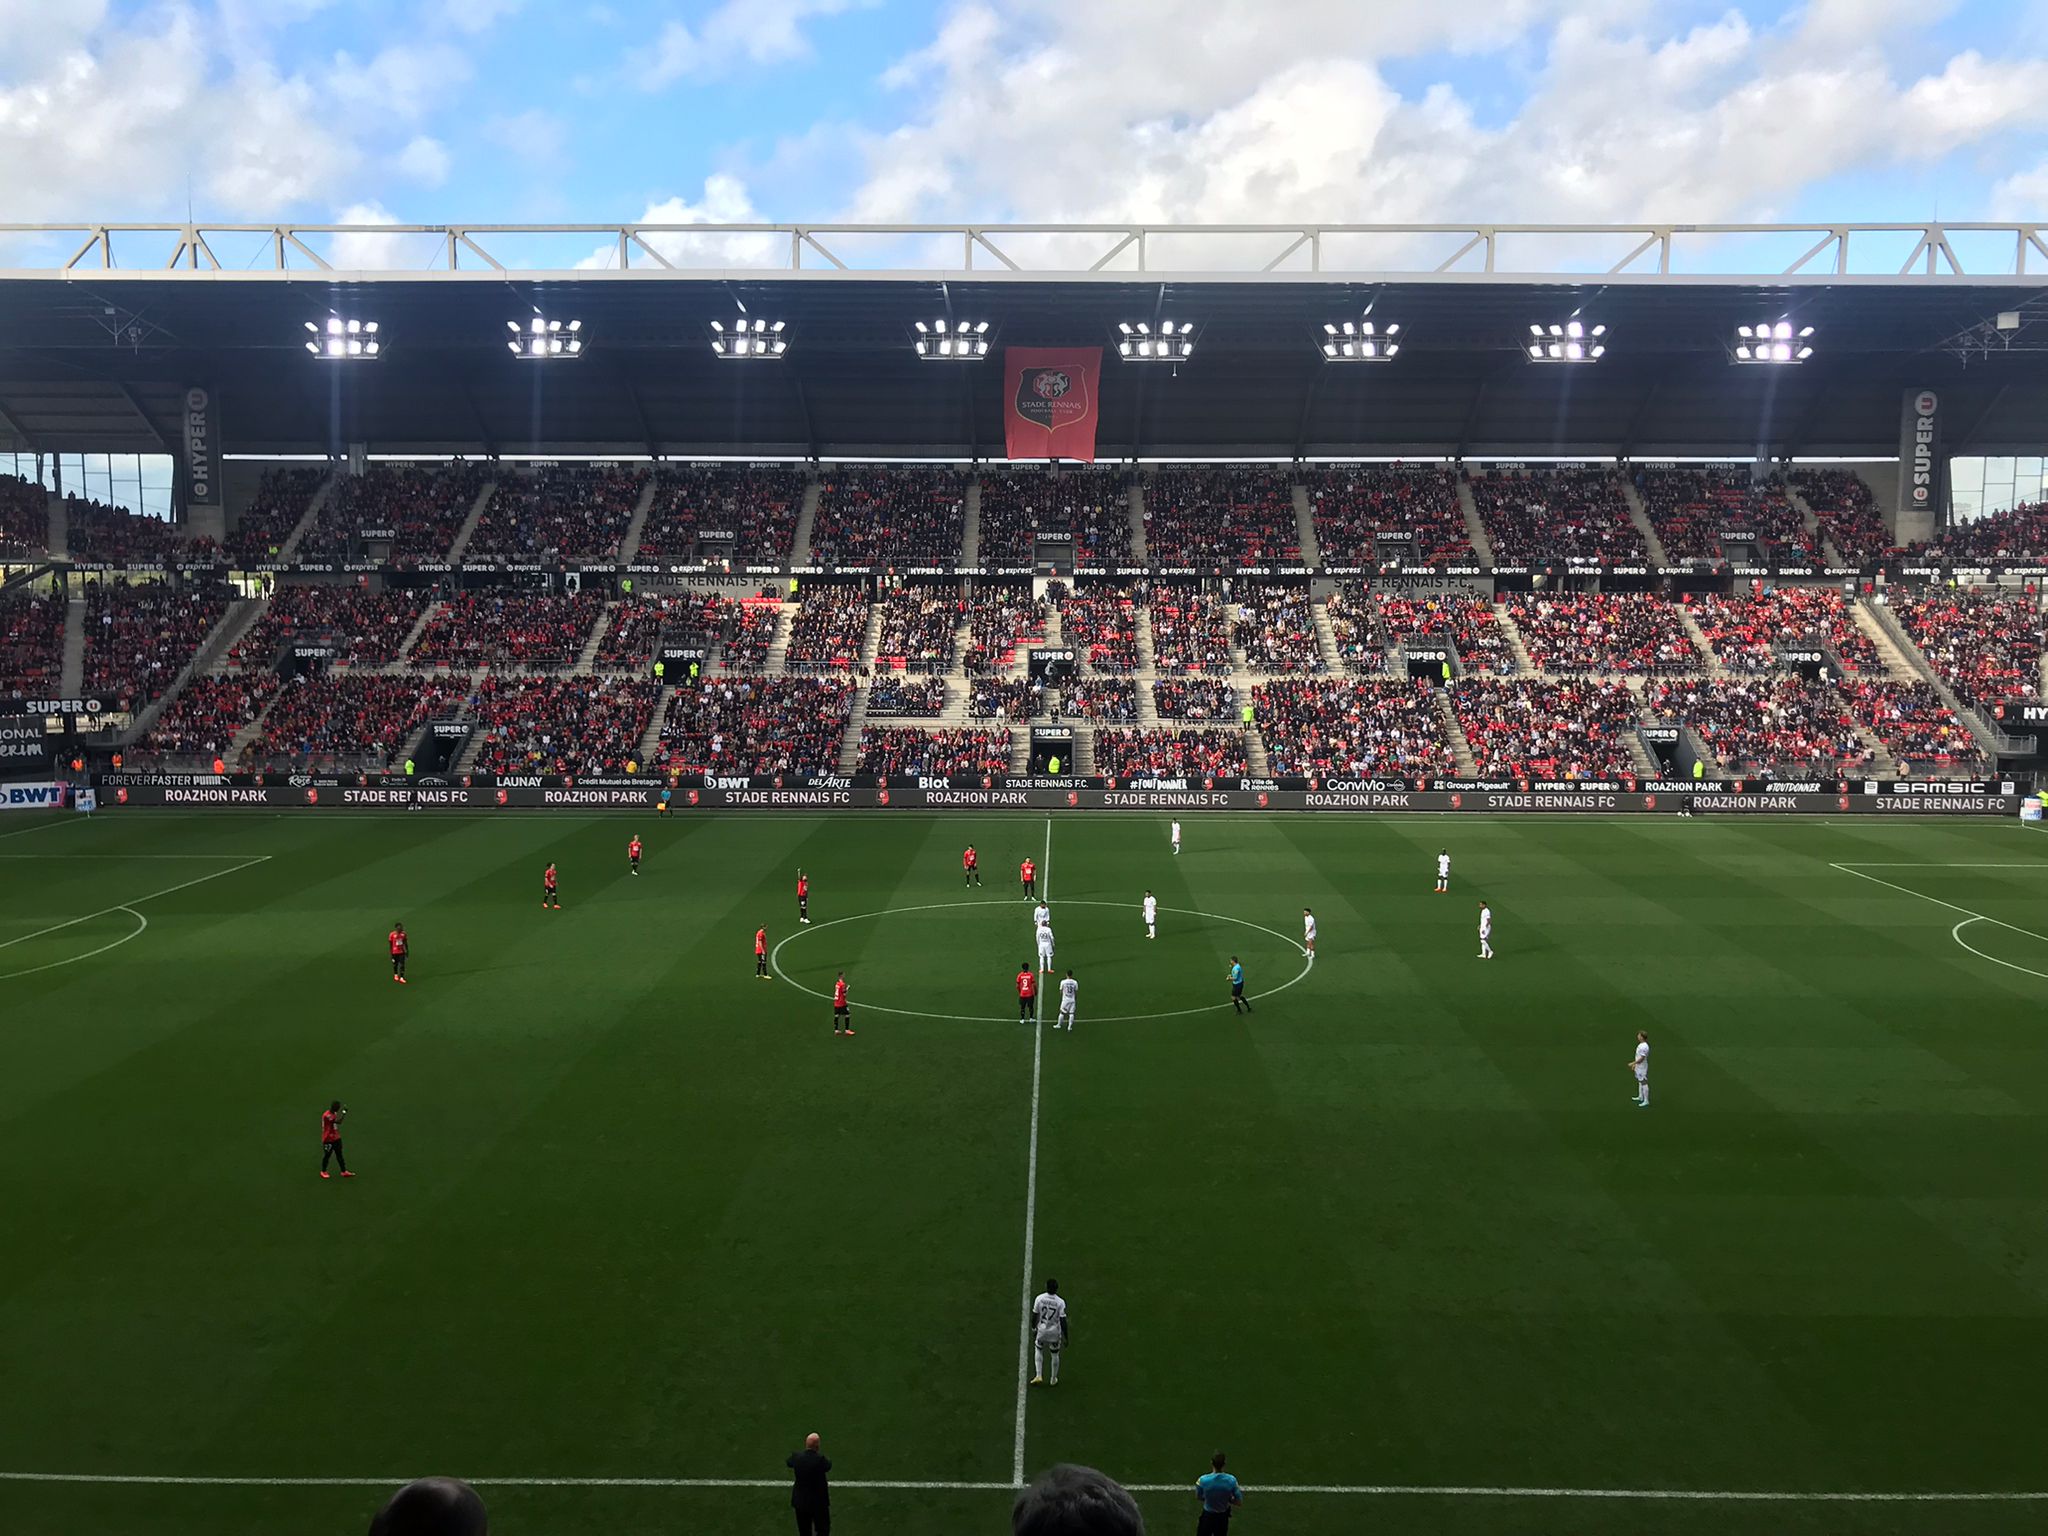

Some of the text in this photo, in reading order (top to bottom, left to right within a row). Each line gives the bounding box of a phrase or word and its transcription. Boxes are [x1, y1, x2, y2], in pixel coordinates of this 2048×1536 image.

[190, 412, 208, 480] HYPER
[1914, 417, 1934, 484] SUPER
[361, 530, 388, 538] SUPER
[1037, 532, 1063, 540] SUPER
[1376, 532, 1404, 540] SUPER
[1720, 532, 1746, 540] SUPER
[351, 564, 378, 572] express
[418, 564, 444, 572] HYPER
[462, 564, 488, 572] SUPER
[514, 564, 542, 572] express
[790, 566, 816, 574] SUPER
[842, 566, 870, 574] express
[2014, 568, 2047, 576] express
[640, 576, 682, 586] STADE
[688, 576, 748, 586] RENNAIS
[1382, 578, 1444, 588] RENNAIS
[294, 648, 326, 657] SUPER
[664, 650, 696, 658] SUPER
[1032, 652, 1064, 660] SUPER
[26, 700, 84, 713] SUPER
[1034, 728, 1062, 736] SUPER
[102, 775, 150, 785] FOREVER
[151, 776, 190, 786] FASTER
[496, 776, 542, 786] LAUNAY
[632, 778, 662, 786] Bretagne
[718, 778, 750, 788] BWT
[808, 778, 822, 786] DEL
[918, 777, 950, 789] Blot
[1006, 780, 1088, 788] STADE RENNAIS F.C.
[1130, 778, 1187, 790] #TOUTDONNER
[1446, 782, 1508, 790] Groupe Pigeault
[1535, 782, 1565, 790] HYPER
[1580, 782, 1610, 790] SUPER
[1645, 782, 1722, 792] ROAZHON PARK
[1766, 782, 1821, 792] #TOUTDONNER
[1894, 782, 1985, 794] SAMSIC
[10, 788, 60, 804] BWT
[166, 790, 268, 802] ROAZHON PARK
[344, 790, 386, 802] STADE
[451, 791, 468, 802] FC
[545, 791, 648, 803] ROAZHON PARK
[726, 792, 850, 803] STADE RENNAIS FC
[926, 792, 1027, 804] ROAZHON PARK
[1104, 793, 1228, 805] STADE RENNAIS FC
[1306, 794, 1409, 806] ROAZHON PARK
[1488, 796, 1616, 807] STADE RENNAIS FC
[1694, 796, 1797, 808] ROAZHON PARK
[1876, 798, 2006, 810] STADE RENNAIS FC
[1042, 1306, 1056, 1320] 27
